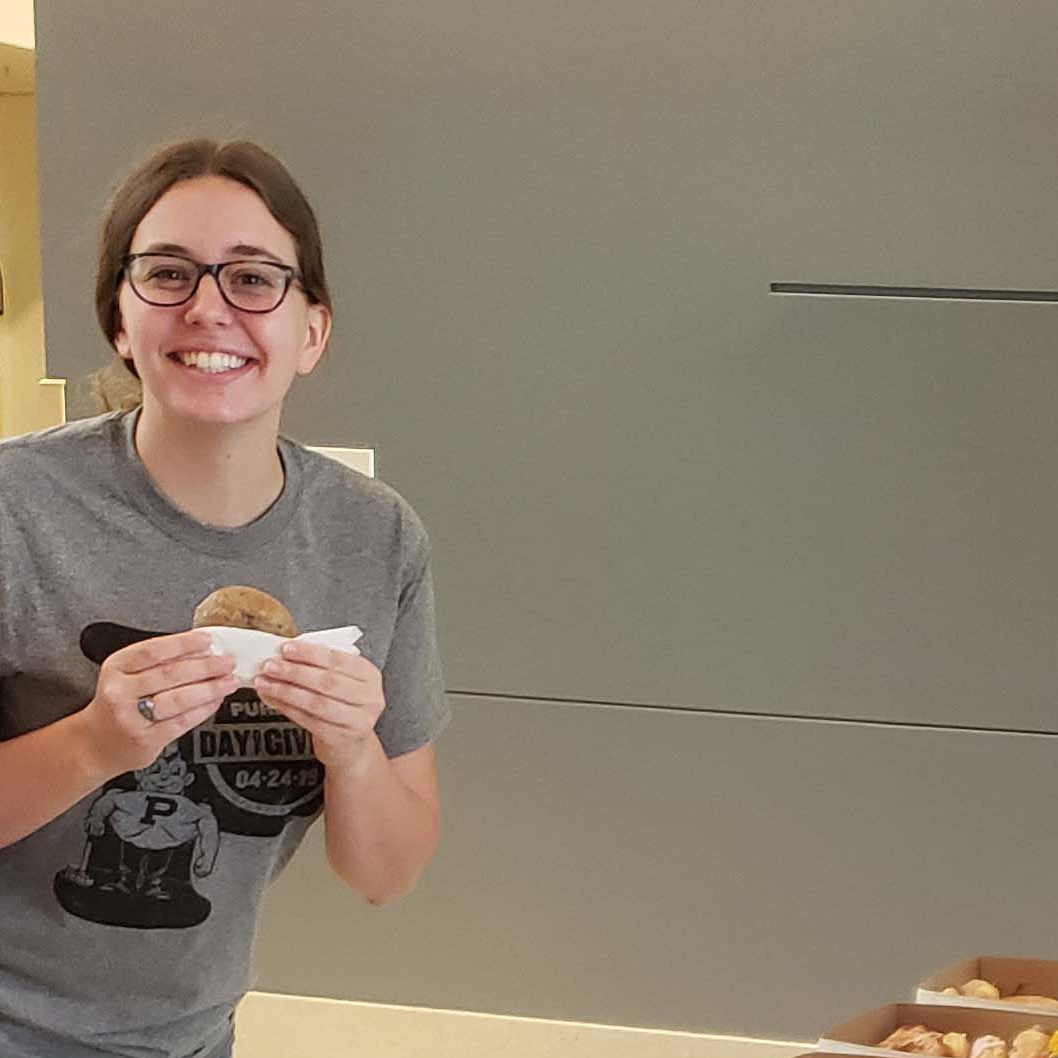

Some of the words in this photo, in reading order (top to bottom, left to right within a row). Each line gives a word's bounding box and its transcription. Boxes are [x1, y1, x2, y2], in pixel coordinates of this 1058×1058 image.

[230, 700, 279, 718] PUR
[200, 729, 251, 758] DAY
[139, 795, 178, 826] P
